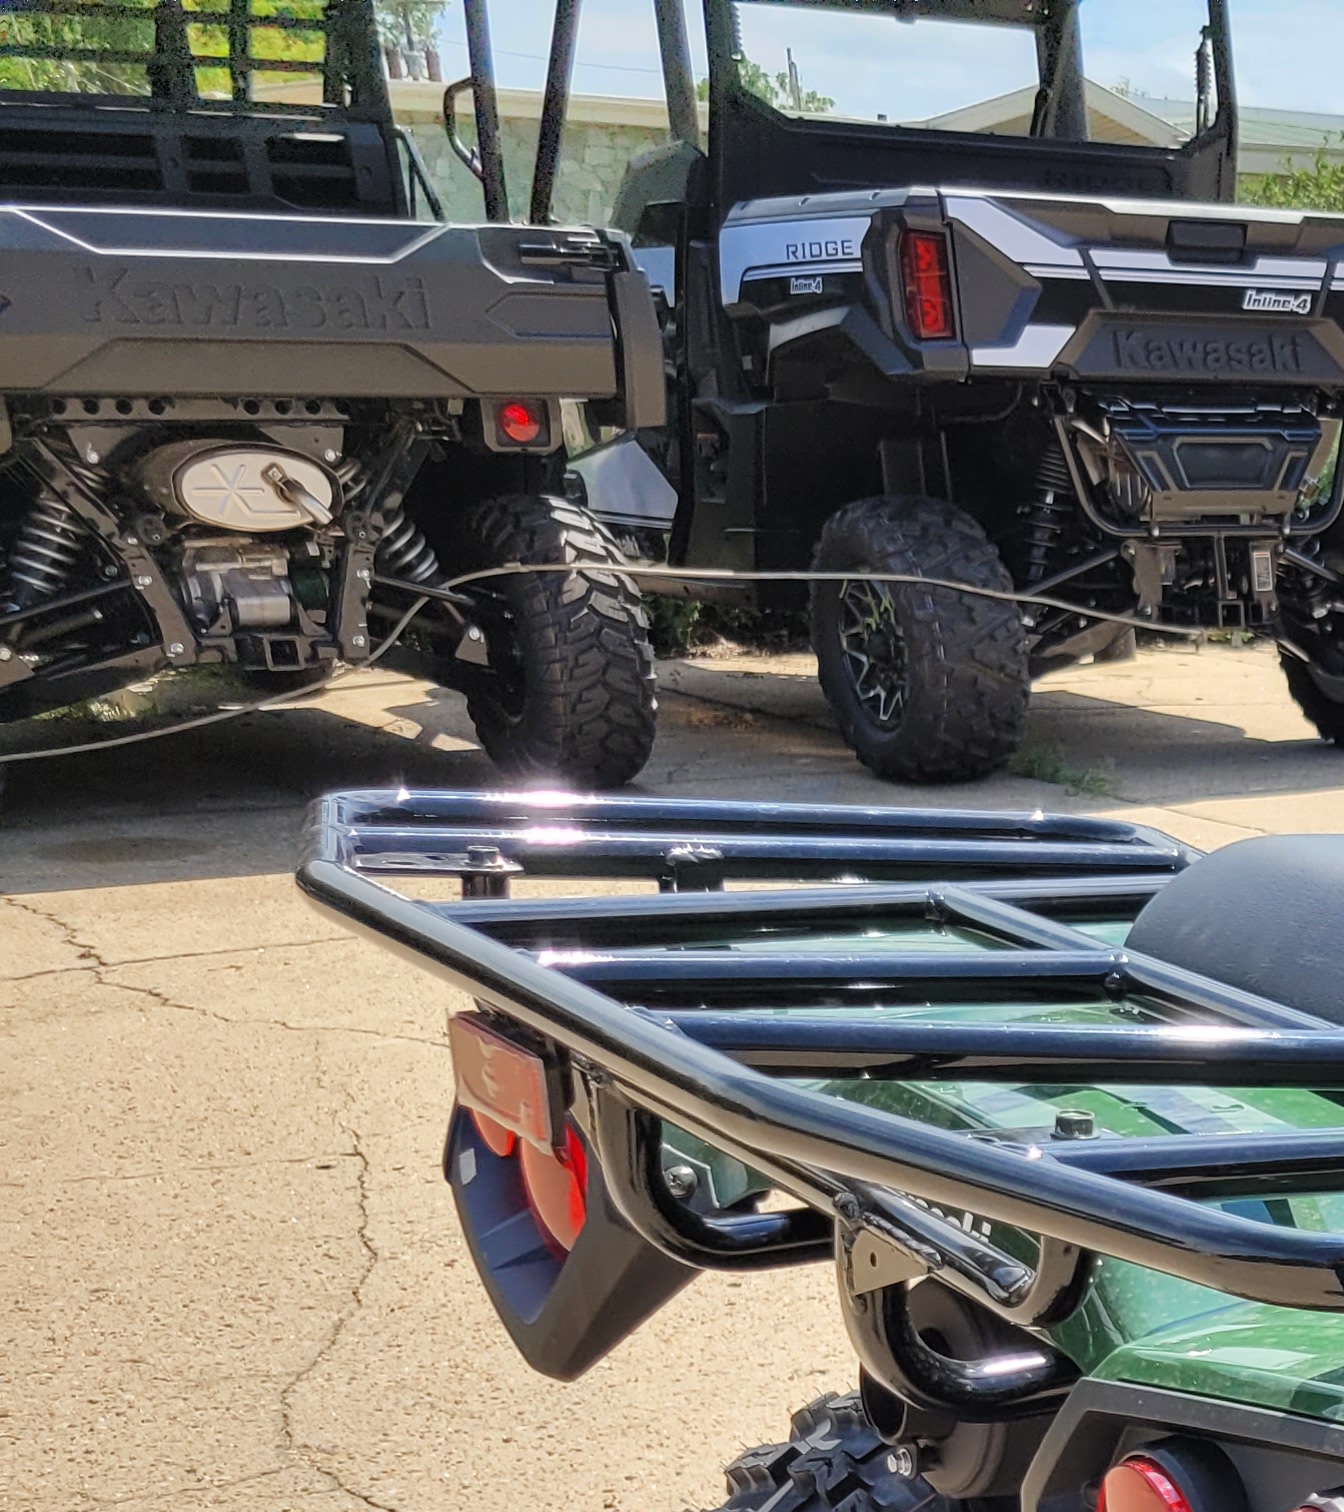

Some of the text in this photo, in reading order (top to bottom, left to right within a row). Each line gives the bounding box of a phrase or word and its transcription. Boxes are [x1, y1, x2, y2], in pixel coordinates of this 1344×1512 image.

[786, 239, 854, 261] RIDGE
[75, 267, 432, 331] Kawasaki
[1243, 290, 1311, 314] Inline-4
[1110, 329, 1304, 373] Kawasaki
